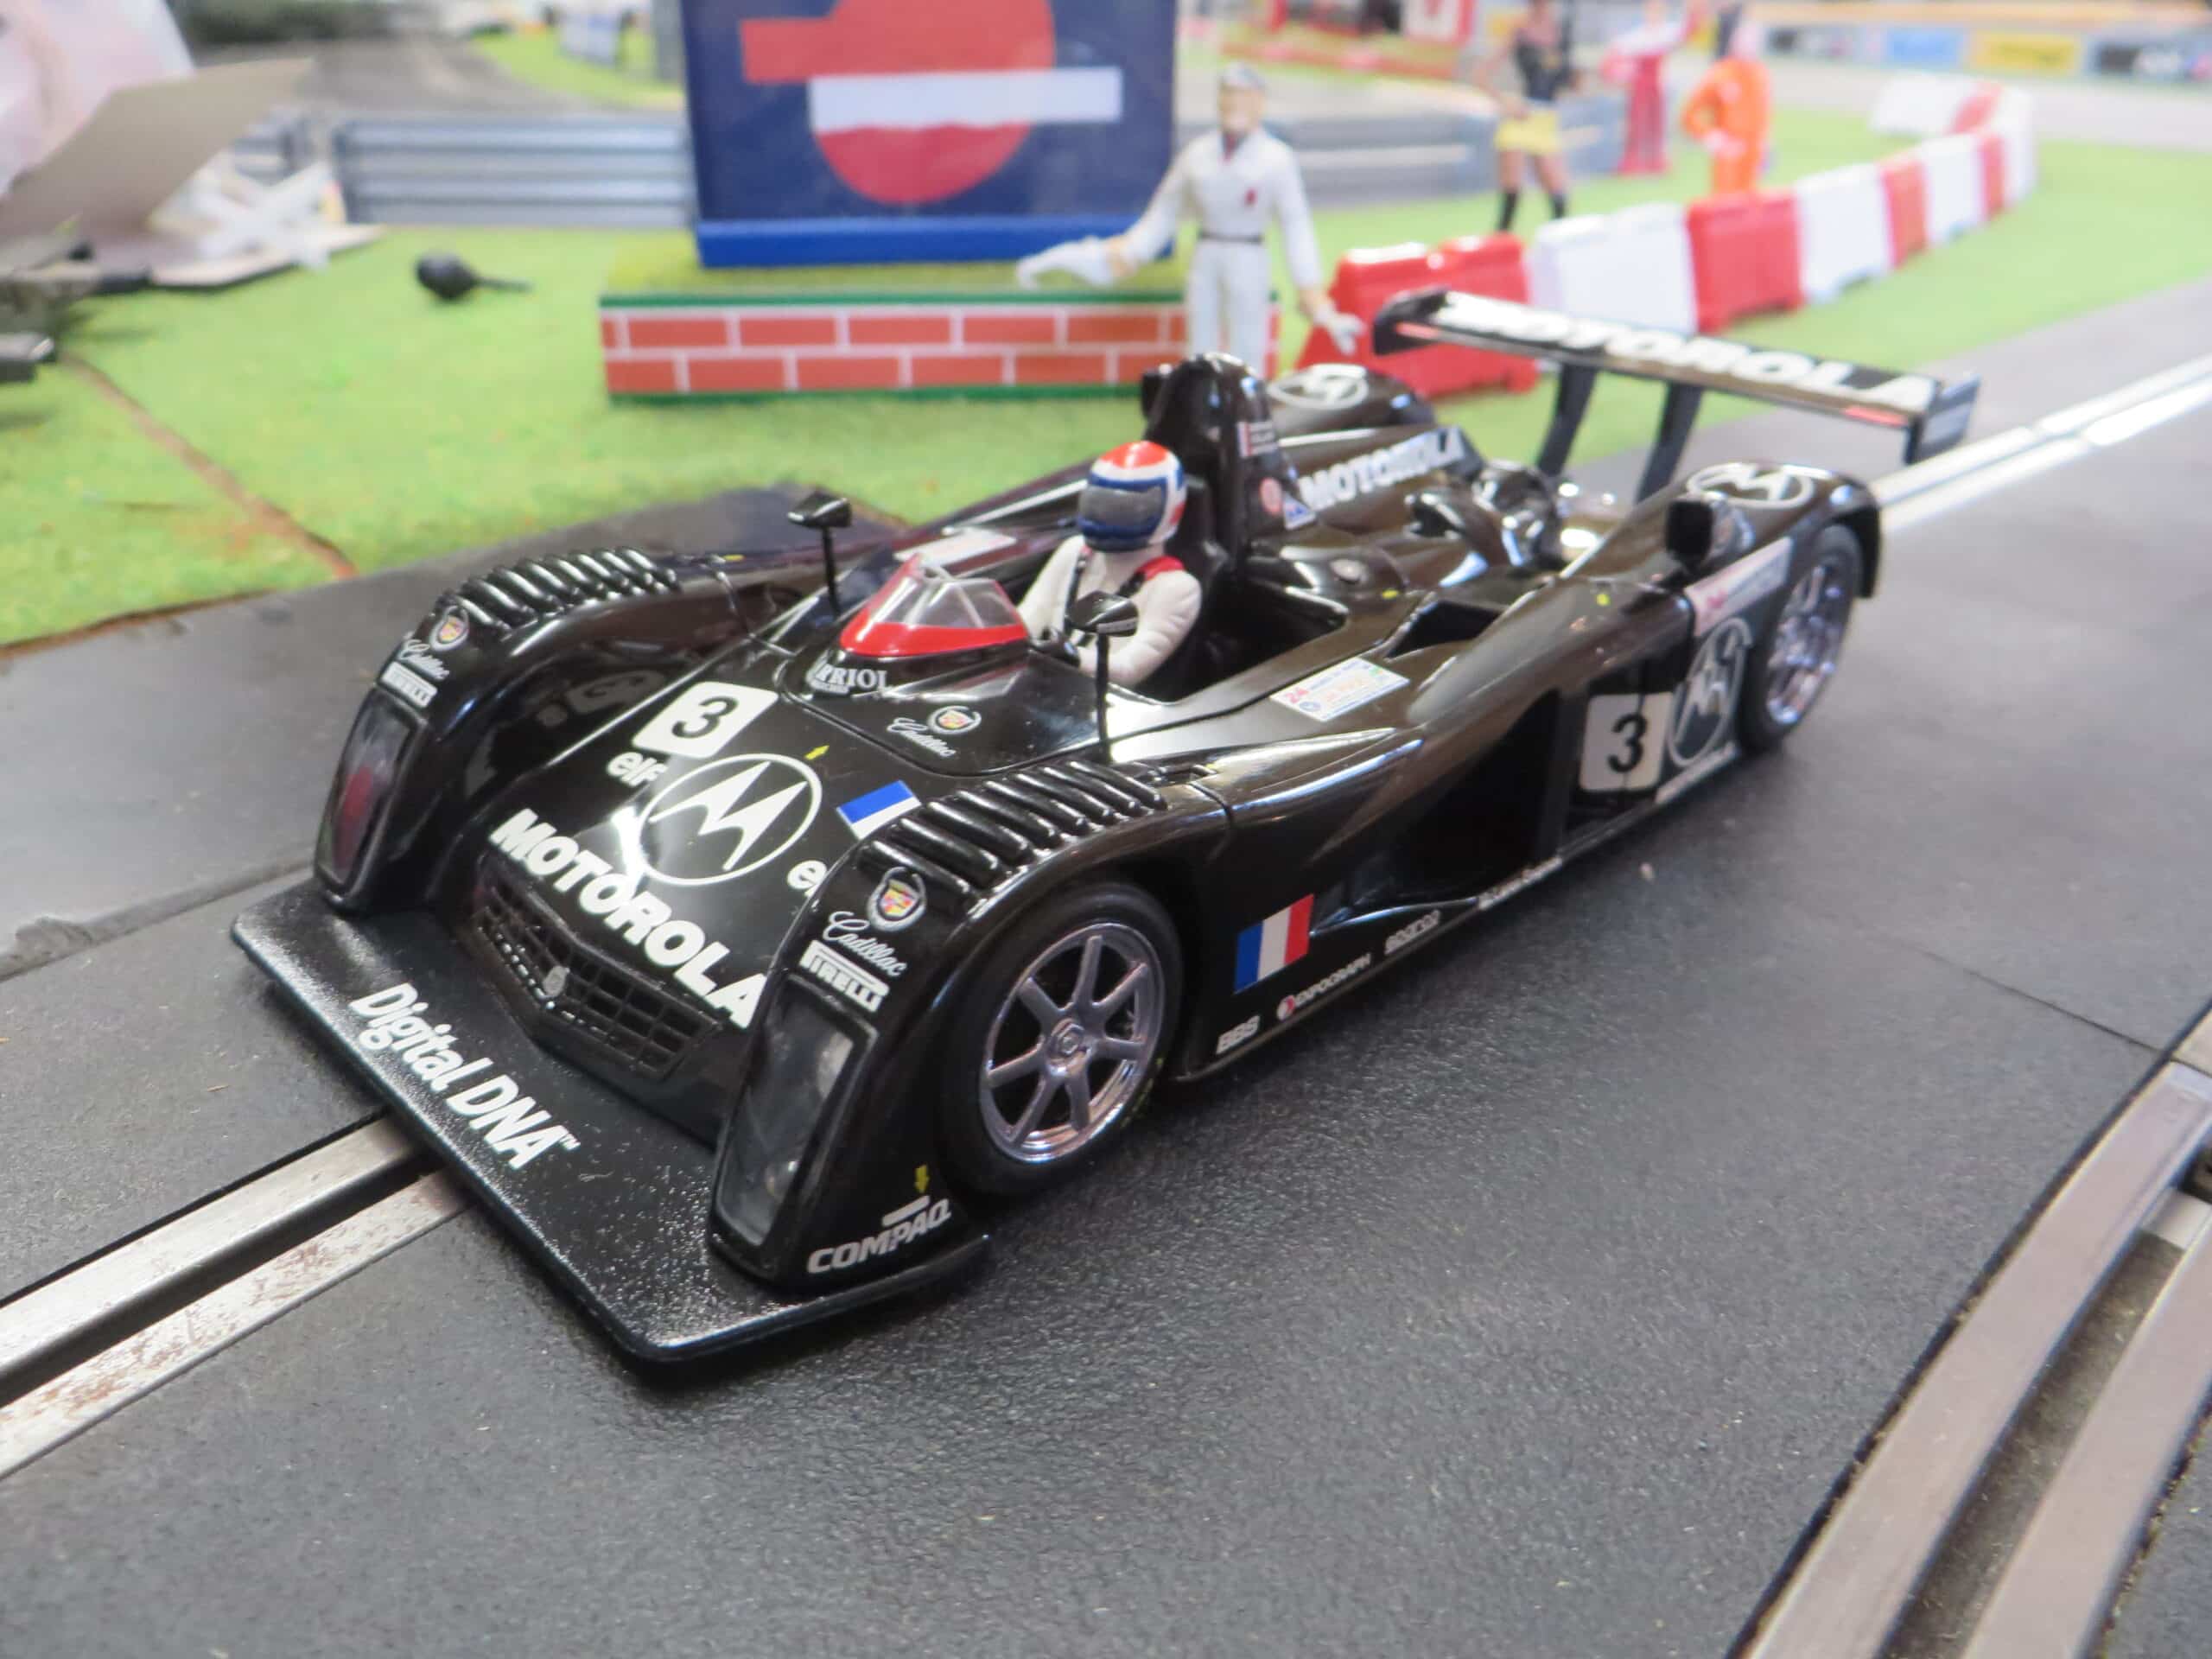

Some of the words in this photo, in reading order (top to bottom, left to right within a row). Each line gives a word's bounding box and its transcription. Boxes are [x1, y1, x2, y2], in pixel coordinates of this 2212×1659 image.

[1296, 426, 1466, 514] MOTOROLA
[671, 696, 739, 739] 3
[1607, 713, 1648, 772] 3
[607, 752, 669, 787] elf
[488, 807, 767, 1028] MOTOROLA
[823, 911, 907, 977] Cadillac
[799, 939, 890, 1013] PIRELLI
[347, 982, 494, 1093] Digital
[806, 1198, 951, 1274] COMPAQ
